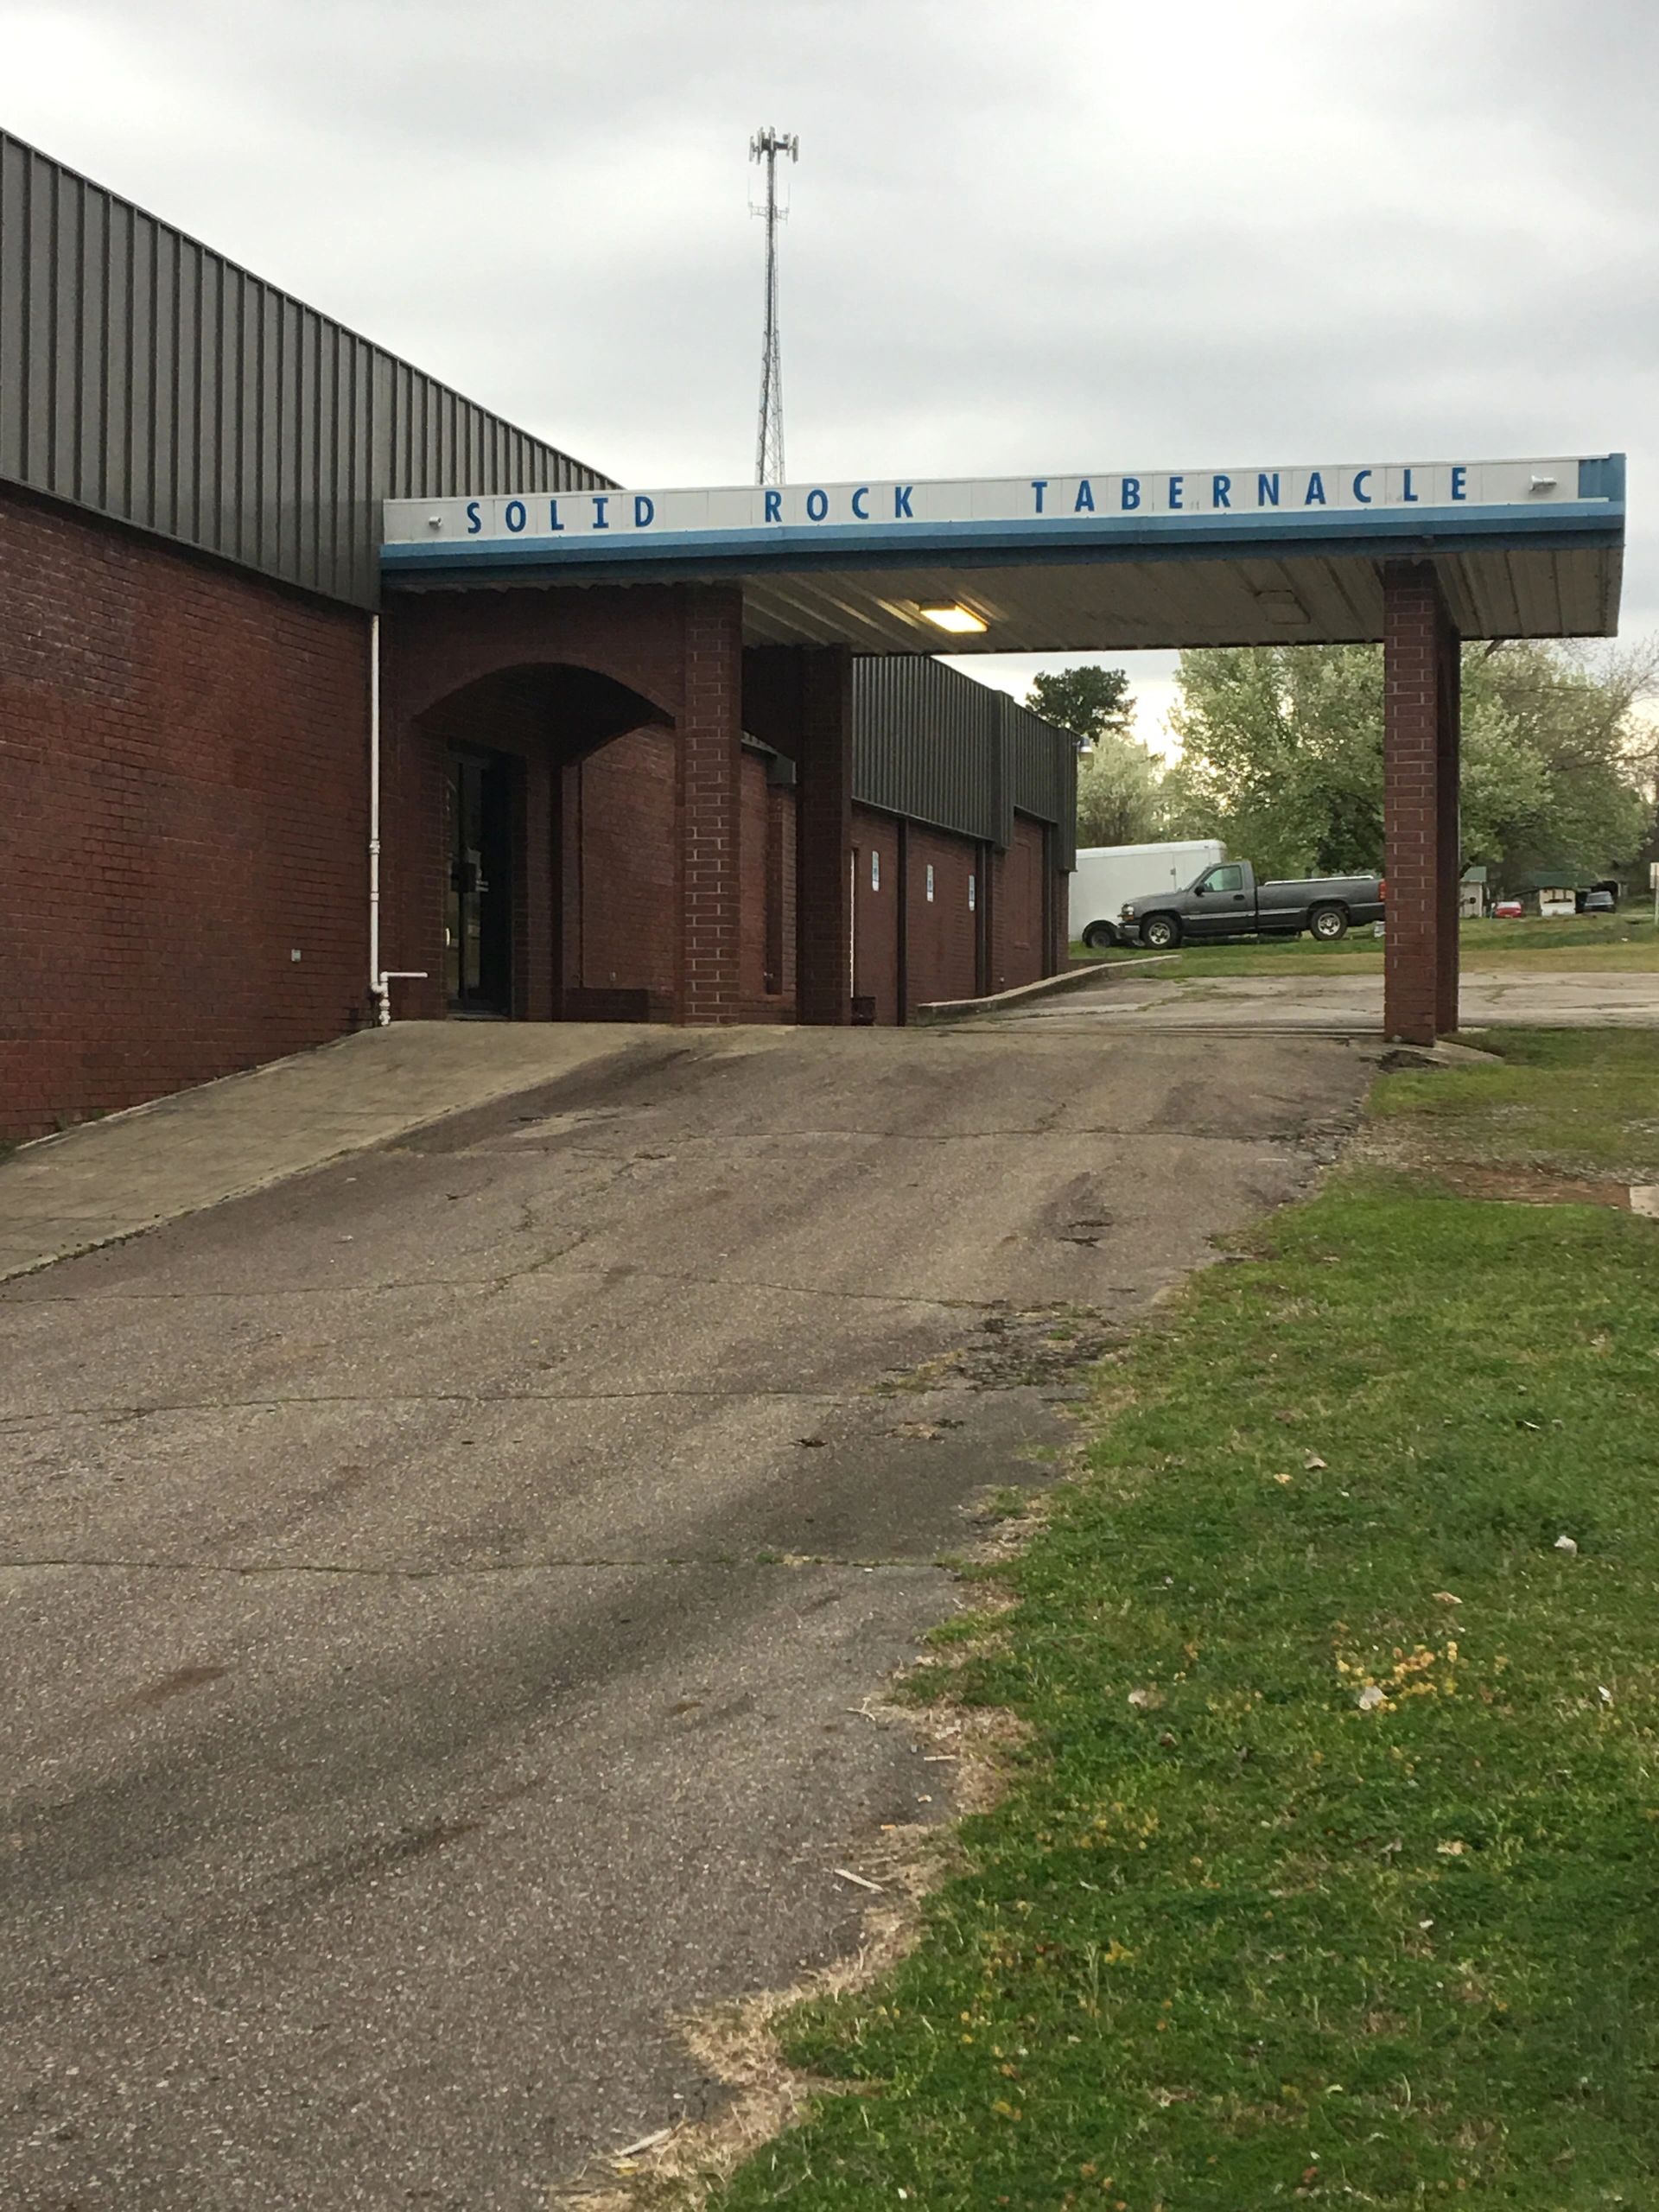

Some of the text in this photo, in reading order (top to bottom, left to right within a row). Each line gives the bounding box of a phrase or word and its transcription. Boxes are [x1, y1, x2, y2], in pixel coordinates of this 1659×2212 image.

[467, 467, 1468, 533] SOLID ROCK TABERNACLE
